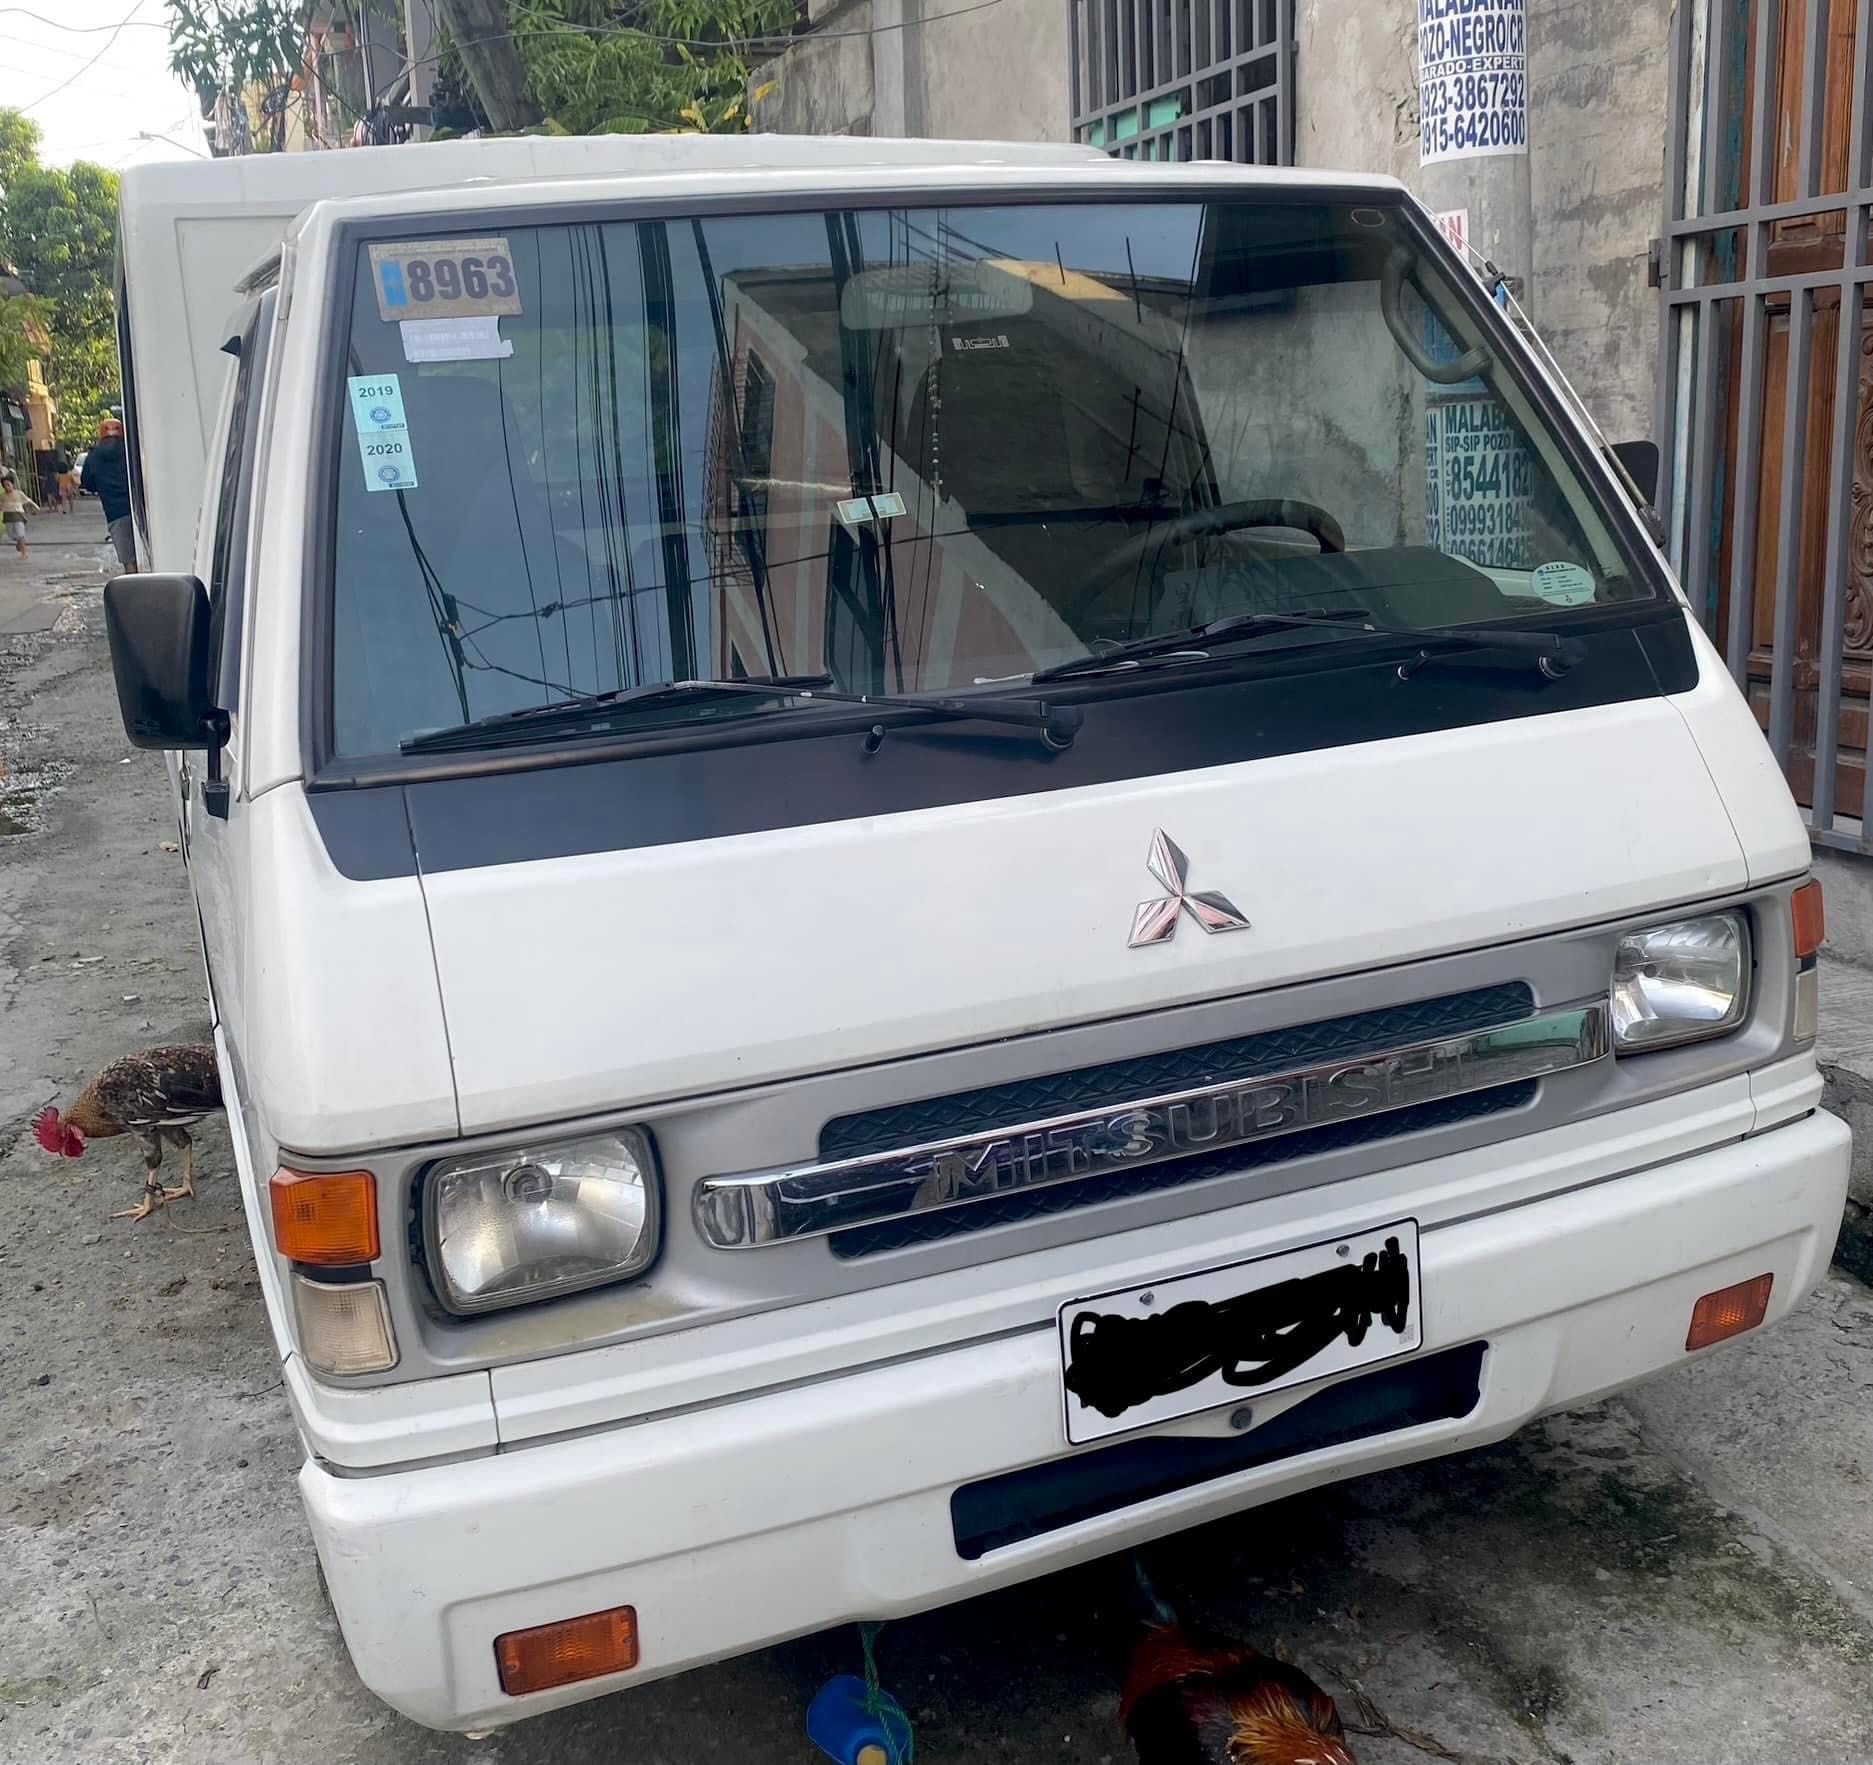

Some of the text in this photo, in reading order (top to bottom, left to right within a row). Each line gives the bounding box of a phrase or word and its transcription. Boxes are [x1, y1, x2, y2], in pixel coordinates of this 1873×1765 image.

[407, 255, 516, 302] 8963
[358, 385, 394, 398] 2019
[367, 442, 402, 456] 2020
[1445, 434, 1480, 453] SIP-SIP
[1484, 433, 1512, 451] POZO
[934, 1042, 1475, 1203] MITSUBISHI
